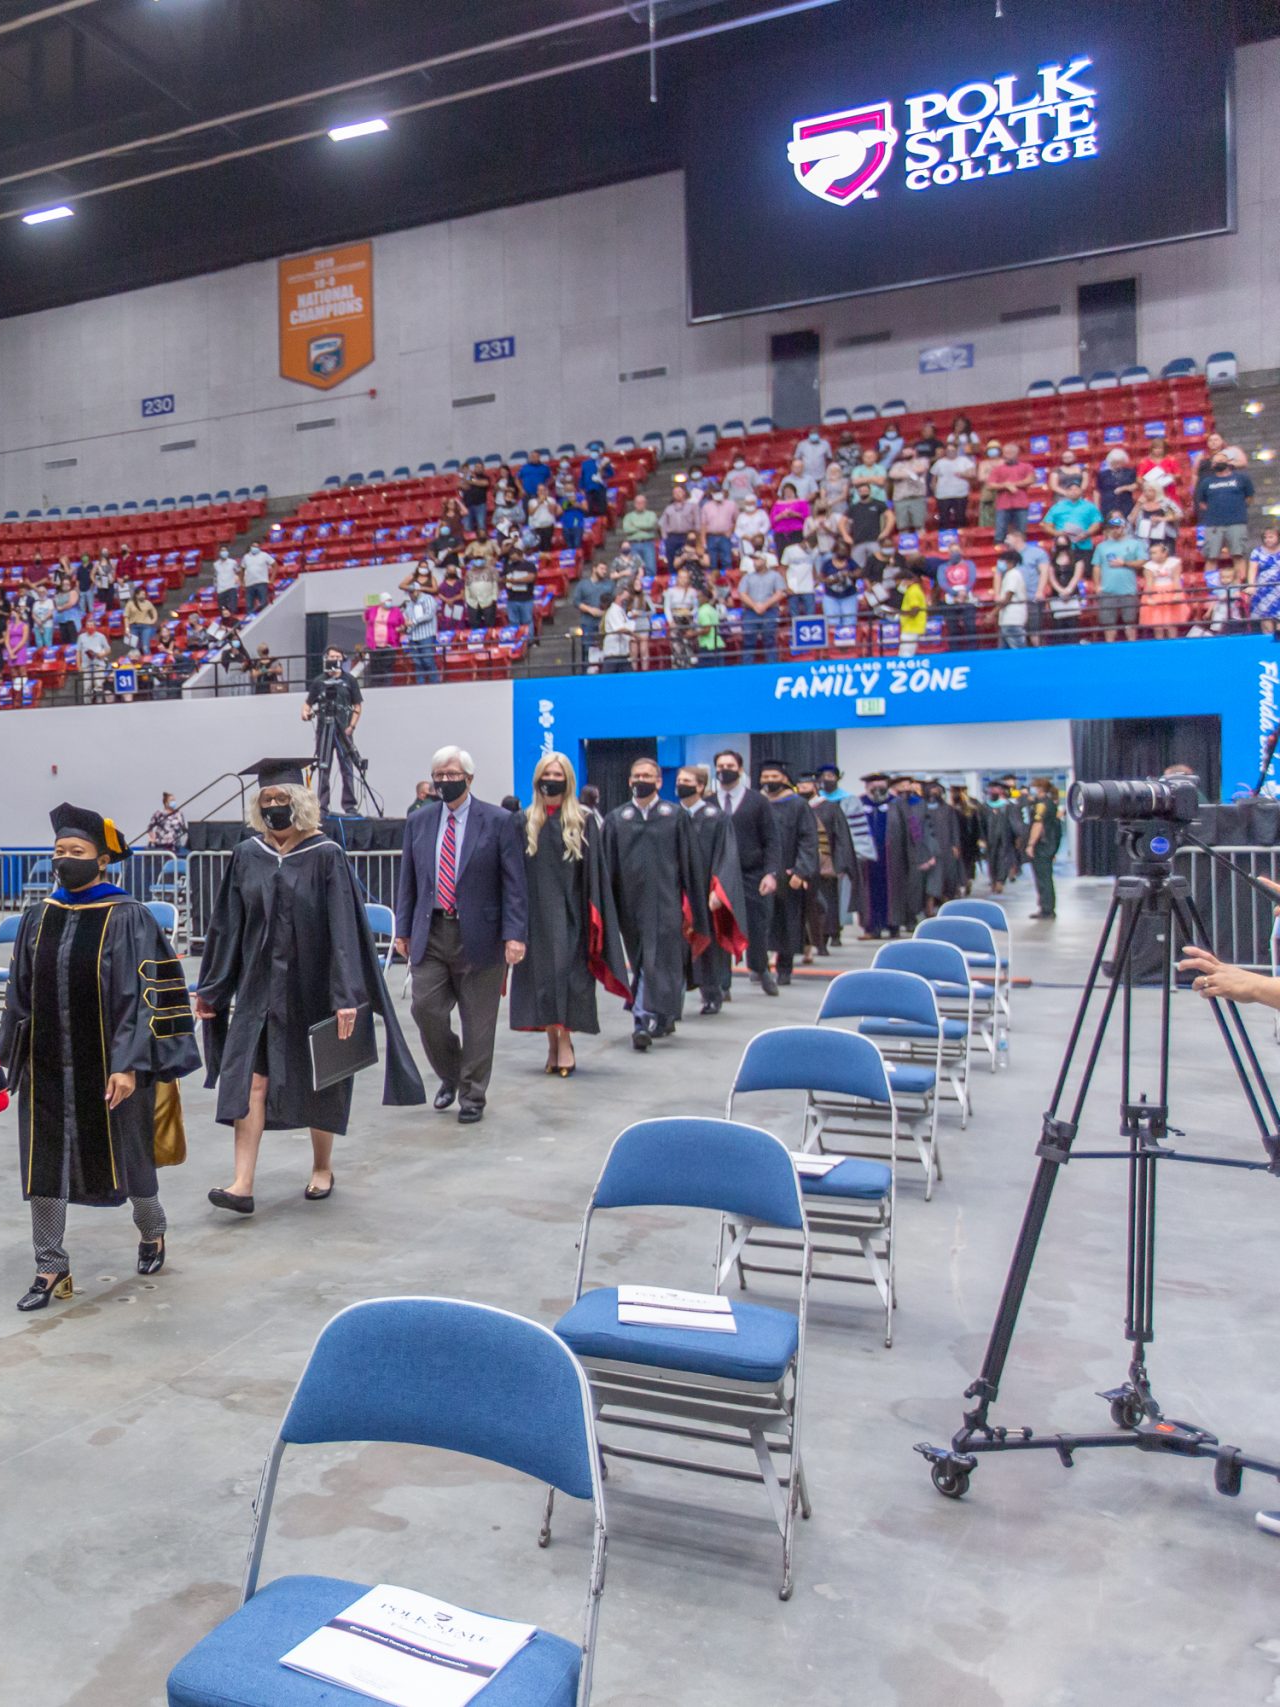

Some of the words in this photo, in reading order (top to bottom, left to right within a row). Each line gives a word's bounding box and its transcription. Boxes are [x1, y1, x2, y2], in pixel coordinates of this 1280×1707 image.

[905, 56, 1097, 135] POLK
[906, 98, 1097, 171] STATE
[906, 136, 1097, 190] COLLEGE
[297, 284, 354, 309] NATIONAL
[289, 297, 363, 325] CHAMPIONS
[480, 340, 510, 359] 231
[144, 397, 172, 415] 230
[799, 626, 823, 642] 32
[810, 660, 881, 675] LAKELAND
[886, 658, 931, 670] MAGIC
[119, 675, 132, 687] 31
[775, 671, 880, 699] FAMILY
[889, 666, 971, 694] ZONE
[1258, 660, 1280, 733] Florida
[362, 1629, 389, 1642] Hundred
[389, 1639, 432, 1657] Twenty-Fourth
